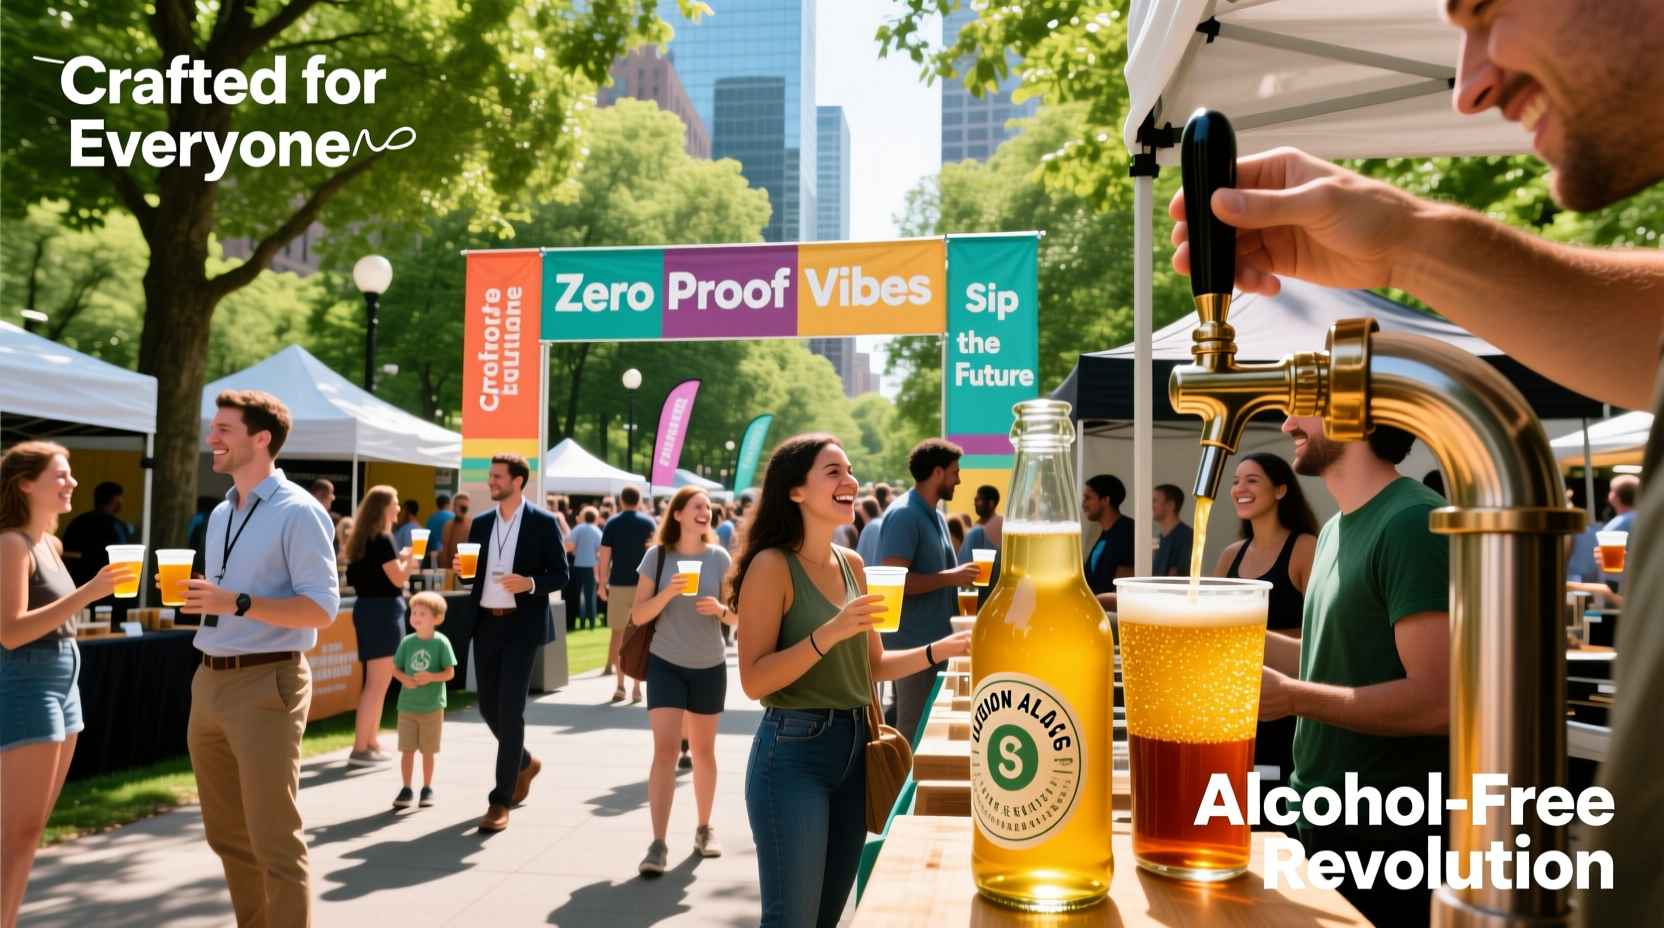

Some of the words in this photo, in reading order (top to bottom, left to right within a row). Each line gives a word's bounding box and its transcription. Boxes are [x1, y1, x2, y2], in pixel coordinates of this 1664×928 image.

[556, 273, 653, 312] Zero
[668, 267, 791, 310] Proof
[804, 266, 932, 307] Vibes
[965, 282, 1019, 321] Sip
[957, 330, 1001, 354] the
[955, 361, 1034, 387] Future
[998, 735, 1024, 779] S
